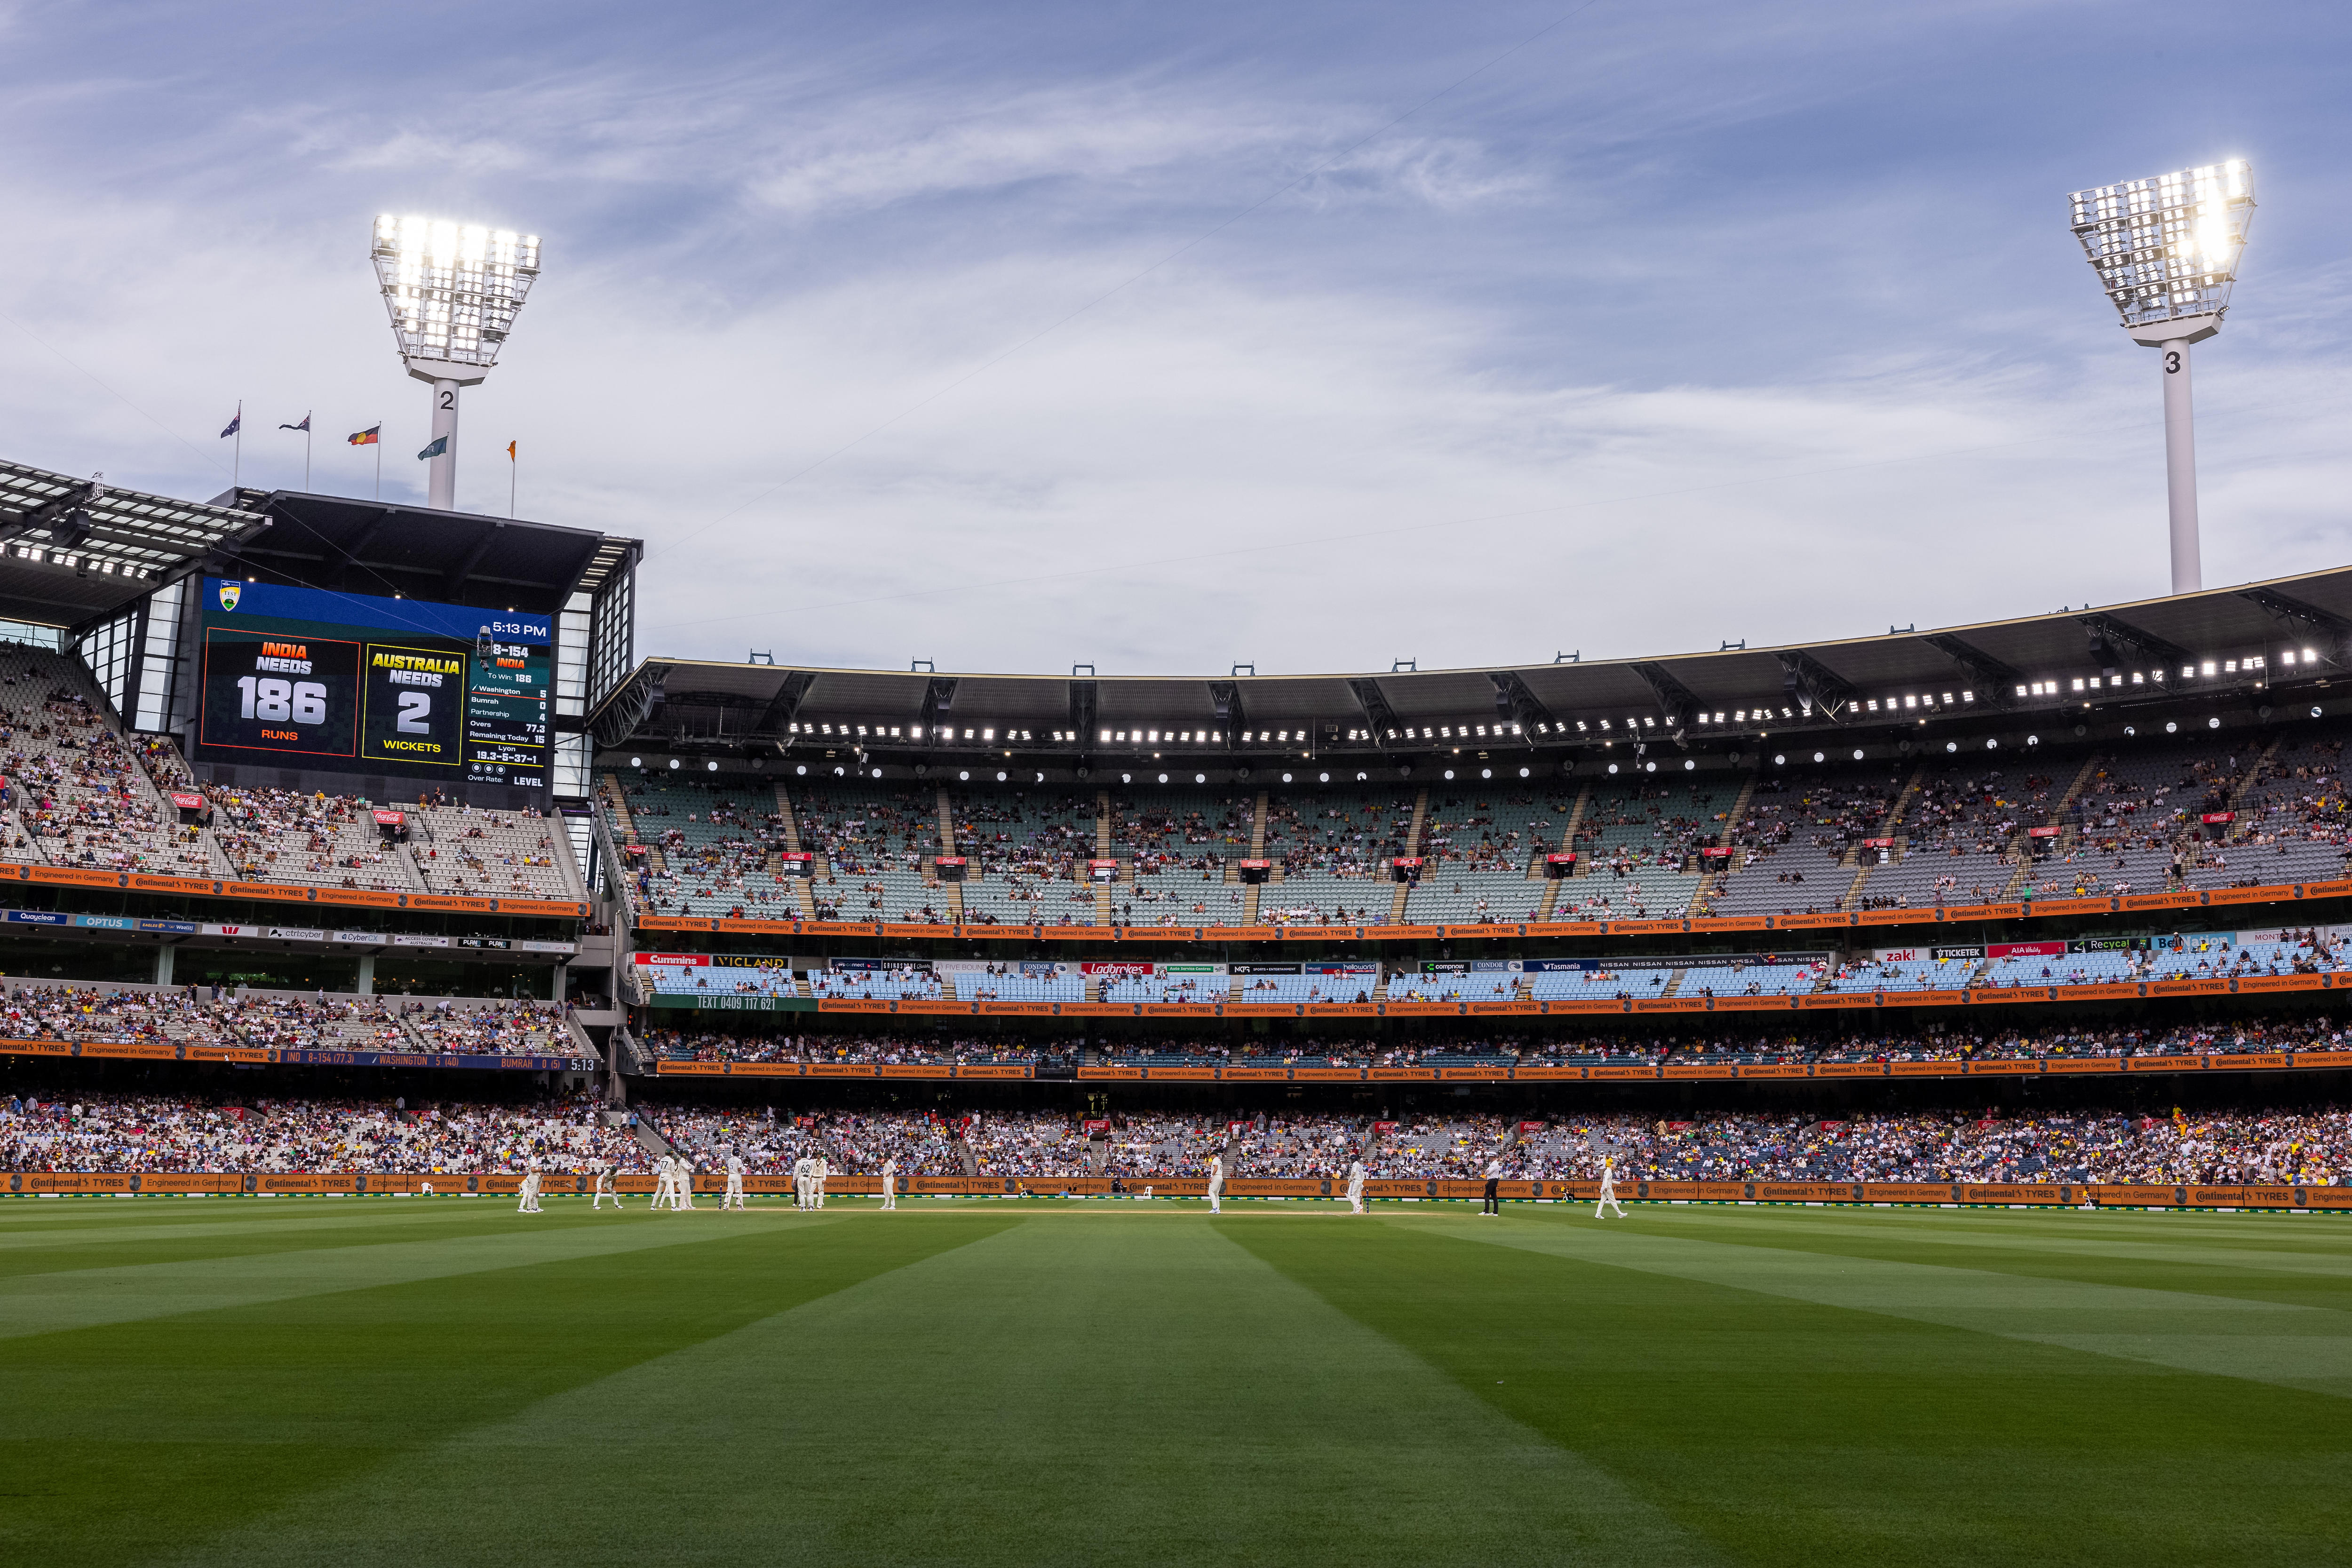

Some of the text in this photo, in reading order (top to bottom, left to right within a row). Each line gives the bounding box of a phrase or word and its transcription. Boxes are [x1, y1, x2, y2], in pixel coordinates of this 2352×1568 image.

[2165, 351, 2181, 374] 3
[440, 390, 454, 410] 2
[493, 621, 546, 637] 5:13 PM
[262, 642, 307, 660] INDIA
[493, 644, 529, 658] 8-154
[256, 656, 312, 675] NEEDS
[372, 653, 460, 675] AUSTRALIA
[496, 657, 525, 669] INDIA
[389, 669, 443, 687] NEEDS
[515, 674, 532, 683] 186
[479, 685, 547, 698] Washington 5
[238, 676, 326, 725] 186
[540, 701, 546, 710] 0
[397, 692, 430, 734] 2
[471, 708, 509, 718] Partnership
[526, 724, 545, 733] 77.3
[262, 730, 298, 741] RUNS
[470, 731, 545, 744] Remaining Today 15
[383, 740, 441, 753] WICKETS
[477, 751, 537, 764] 19.3-5-37-1
[514, 777, 543, 787] LEVEL
[84, 875, 114, 883] Germany
[136, 878, 175, 887] Continental
[1951, 909, 1986, 918] Continental
[87, 918, 123, 927] OPTUS
[2091, 939, 2129, 949] Recycal
[2158, 935, 2228, 948] BeNation
[1887, 949, 1915, 962] zak!
[2026, 946, 2041, 954] Vitality
[650, 955, 697, 964] Cummins
[718, 956, 784, 968] VICLAND
[1091, 963, 1144, 974] Ladbrokes
[698, 996, 775, 1010] TEXT 0409 117 621
[287, 1051, 354, 1065] IND 8-154 (77.3)
[380, 1055, 459, 1067] WASHINGTON 5 (40)
[501, 1058, 560, 1070] BUMRAH 0 (5)
[571, 1059, 594, 1071] 5:13
[660, 1161, 668, 1170] 77
[801, 1164, 810, 1173] 62
[31, 1178, 79, 1189] Continental
[202, 1179, 238, 1187] Germany
[1969, 1189, 2015, 1199] Continental
